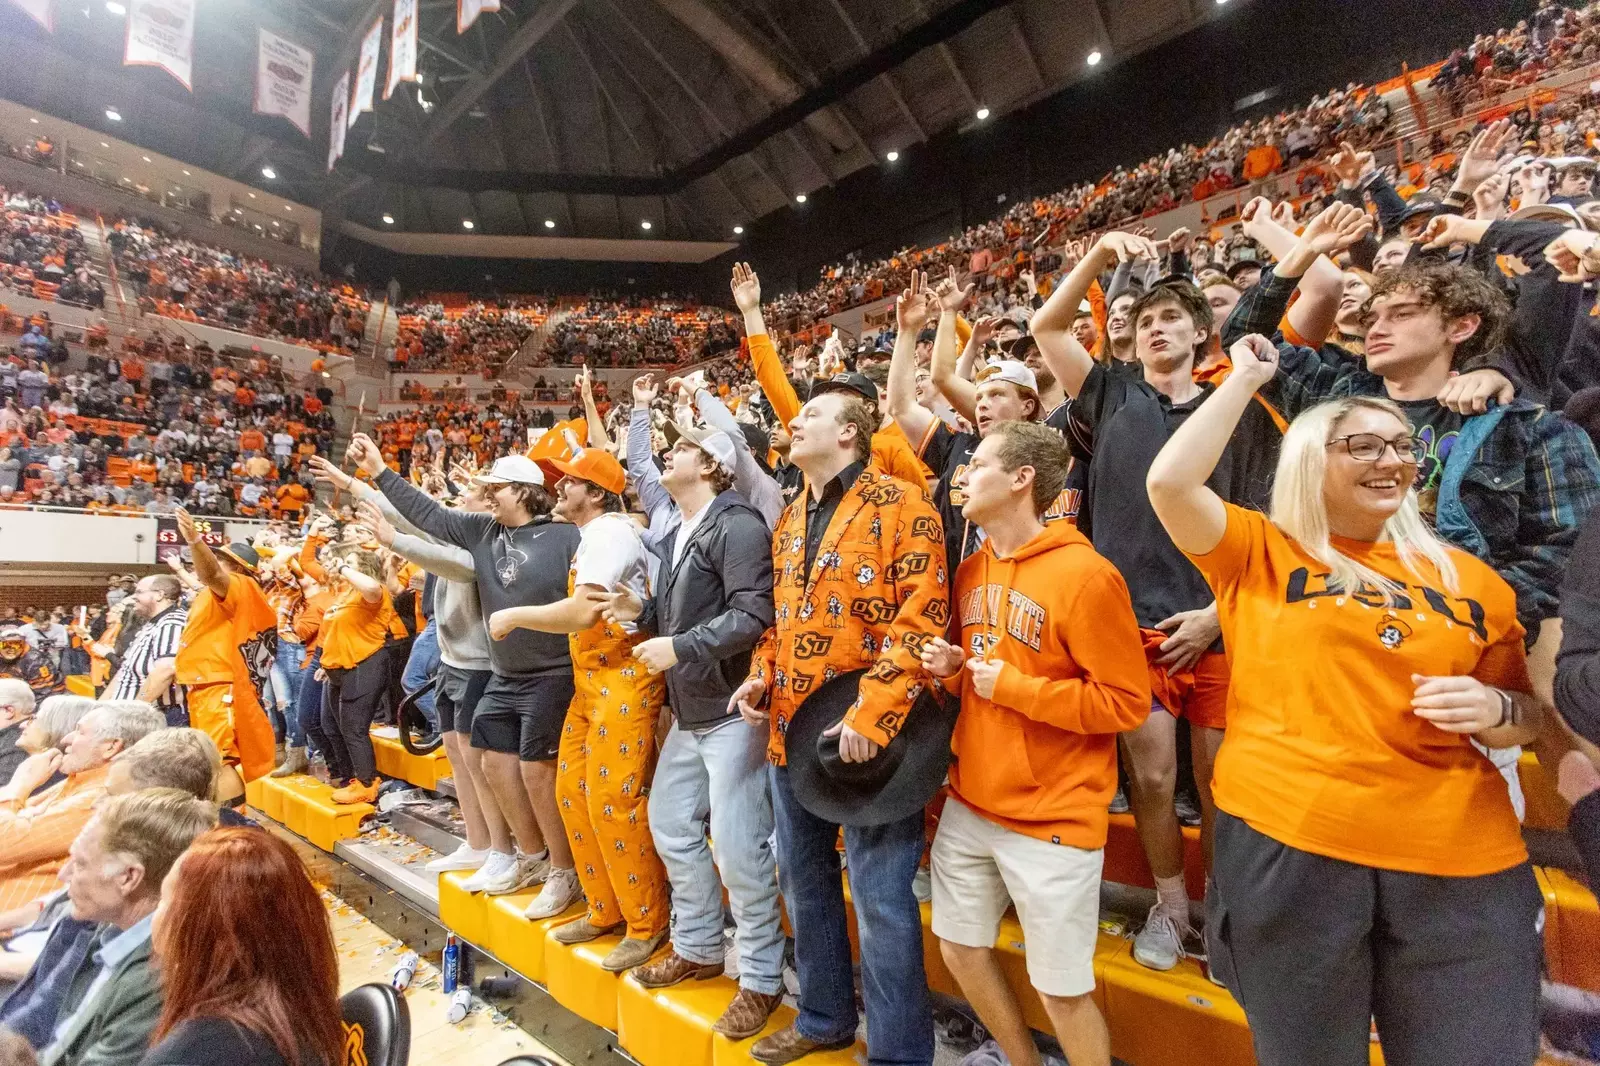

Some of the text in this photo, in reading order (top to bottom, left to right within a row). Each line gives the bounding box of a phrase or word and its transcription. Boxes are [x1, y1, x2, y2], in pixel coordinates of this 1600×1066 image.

[159, 531, 178, 542] 63
[911, 516, 944, 544] OSU
[884, 551, 931, 584] OSU
[850, 597, 898, 625] OSU
[921, 598, 949, 628] OS
[1006, 587, 1046, 653] TATE
